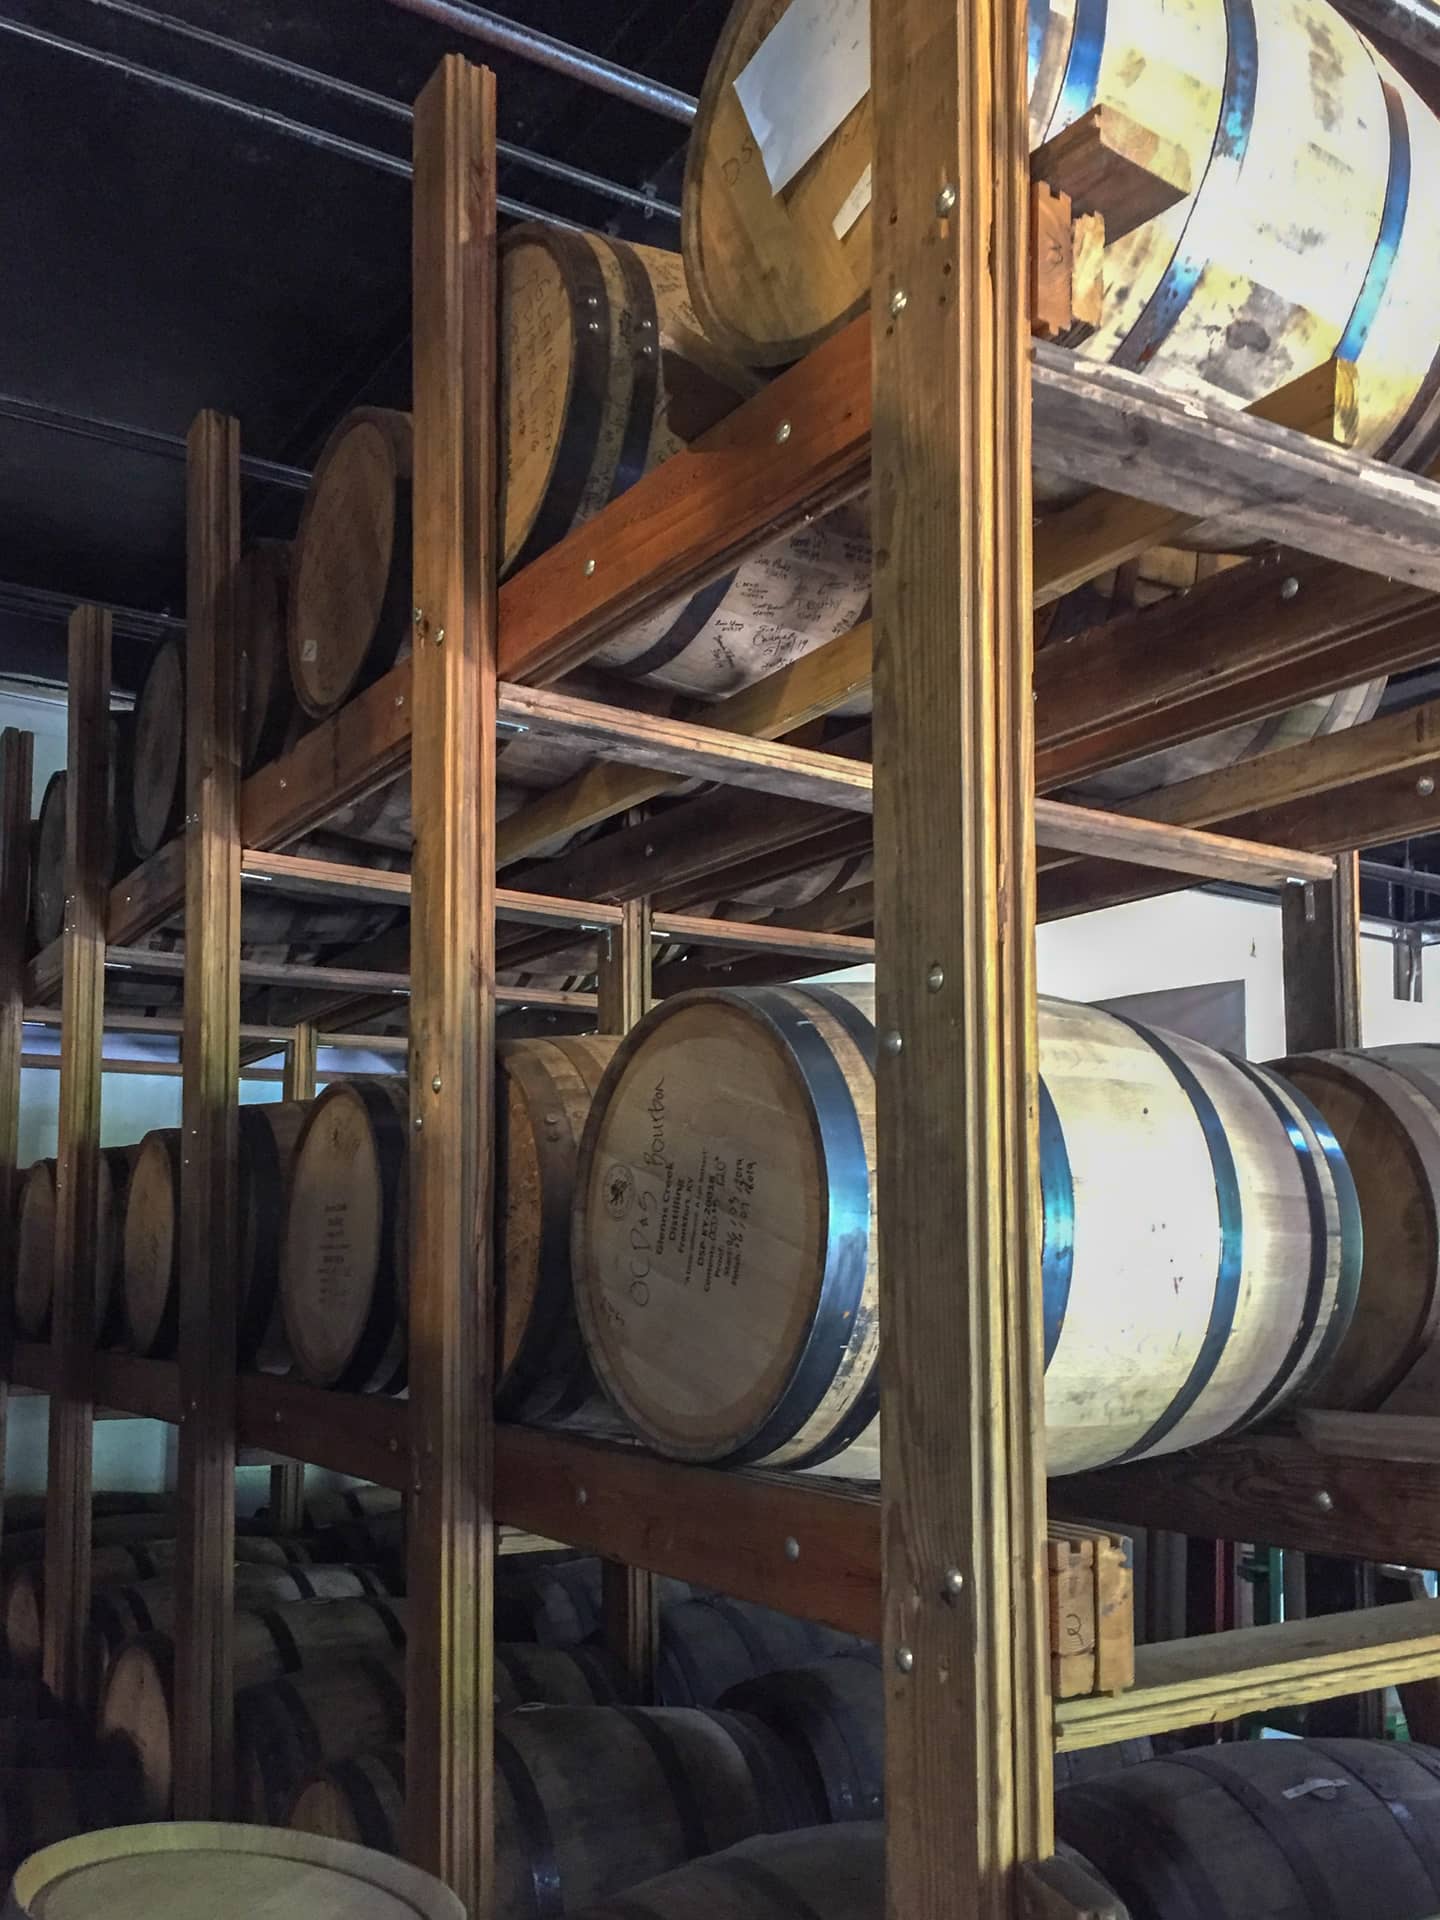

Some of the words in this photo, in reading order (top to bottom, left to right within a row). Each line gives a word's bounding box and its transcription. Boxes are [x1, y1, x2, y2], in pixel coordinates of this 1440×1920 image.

[643, 1075, 666, 1169] Bourbon
[662, 1162, 674, 1203] Creek
[685, 1176, 694, 1192] KY
[656, 1207, 669, 1255] Glenns
[669, 1178, 685, 1241] Distilling
